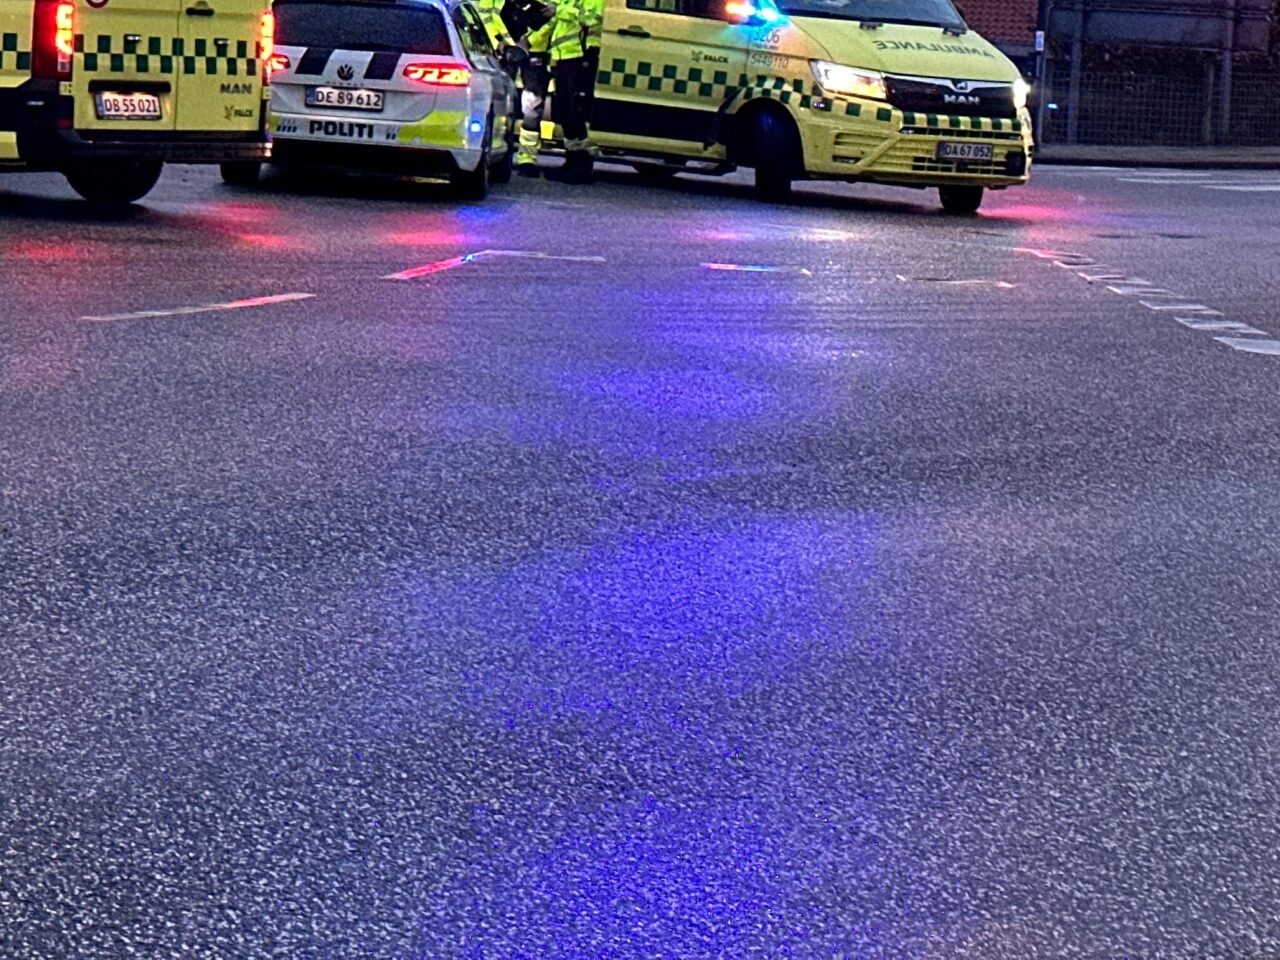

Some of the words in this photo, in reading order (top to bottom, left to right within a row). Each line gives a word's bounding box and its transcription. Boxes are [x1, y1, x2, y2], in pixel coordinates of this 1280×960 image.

[753, 27, 781, 44] 3206
[703, 54, 729, 64] FALCK
[220, 83, 252, 94] MAN
[104, 98, 120, 113] DB
[123, 99, 136, 113] 55
[138, 99, 158, 113] 021
[316, 90, 334, 104] DE
[337, 91, 354, 105] 89
[357, 93, 381, 107] 612
[944, 94, 980, 105] MAN
[309, 120, 374, 138] POLITI
[945, 144, 958, 156] DA
[959, 145, 971, 156] 67
[973, 146, 991, 158] 052
